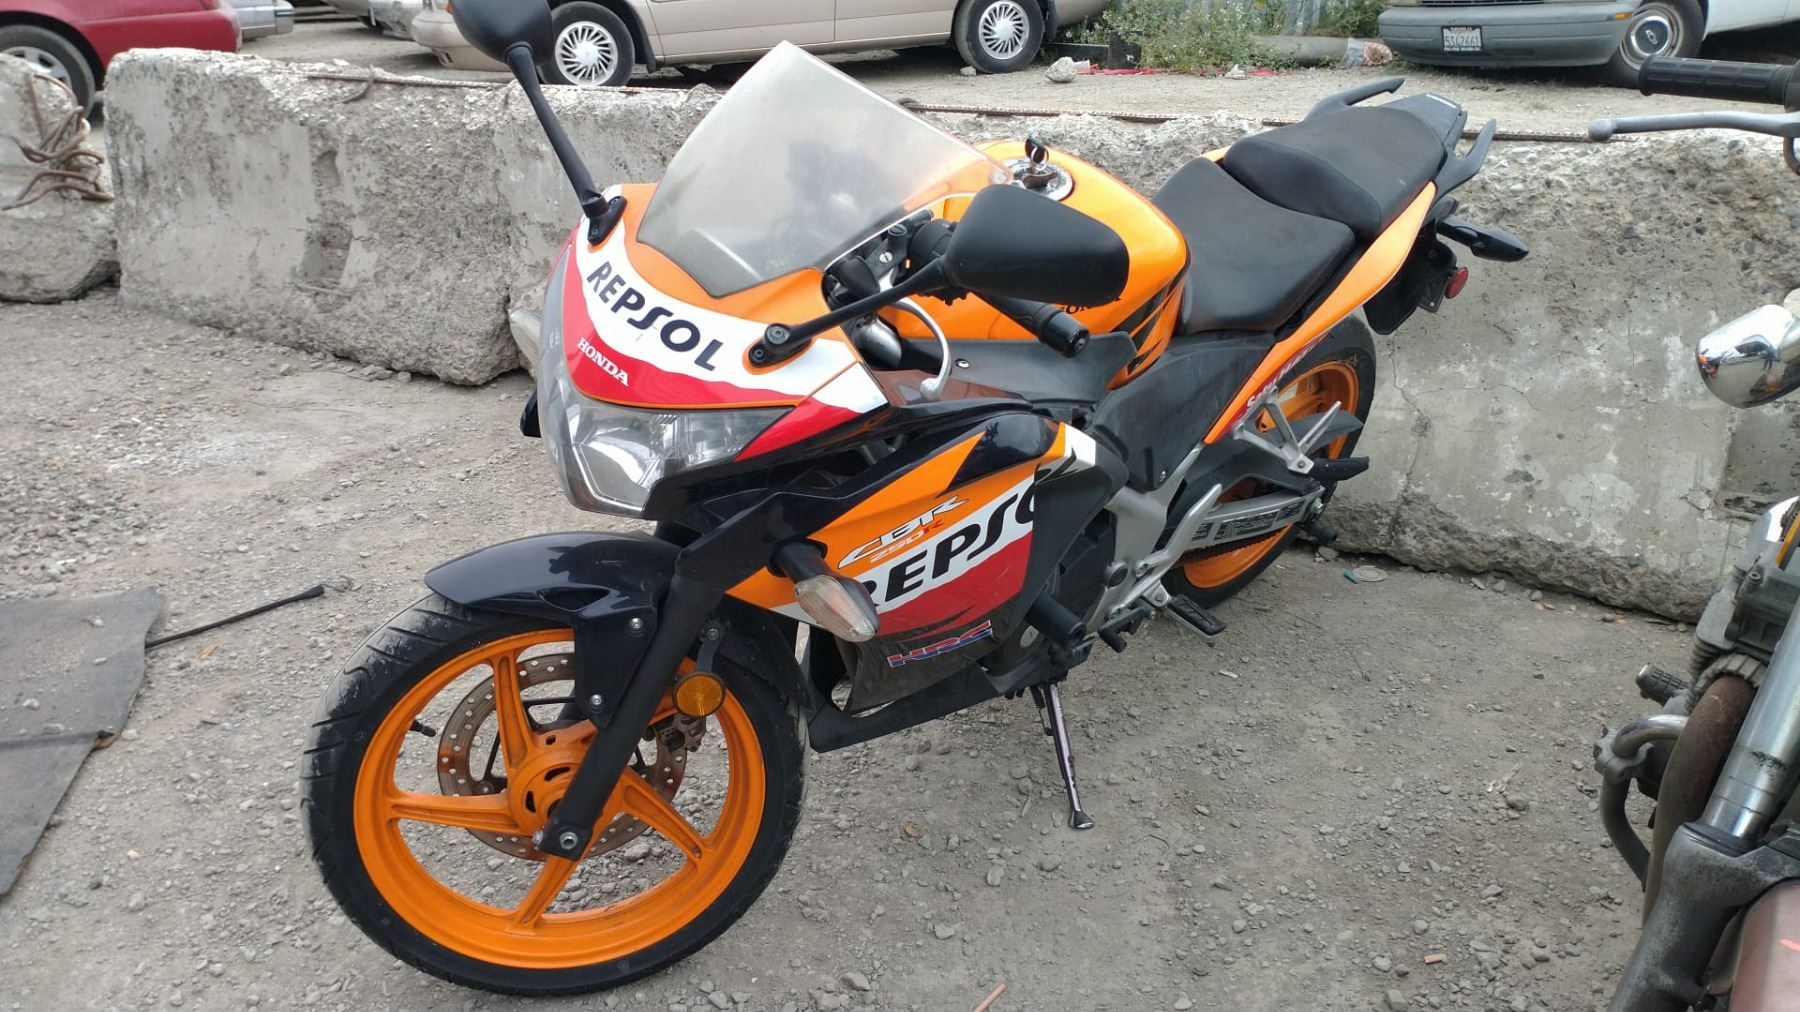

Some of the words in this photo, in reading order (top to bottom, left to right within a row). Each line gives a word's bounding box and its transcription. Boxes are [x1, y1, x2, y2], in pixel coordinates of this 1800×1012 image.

[586, 261, 724, 371] REPSOL
[577, 337, 629, 387] HONDA
[837, 494, 969, 570] CBR
[887, 619, 993, 668] HRC
